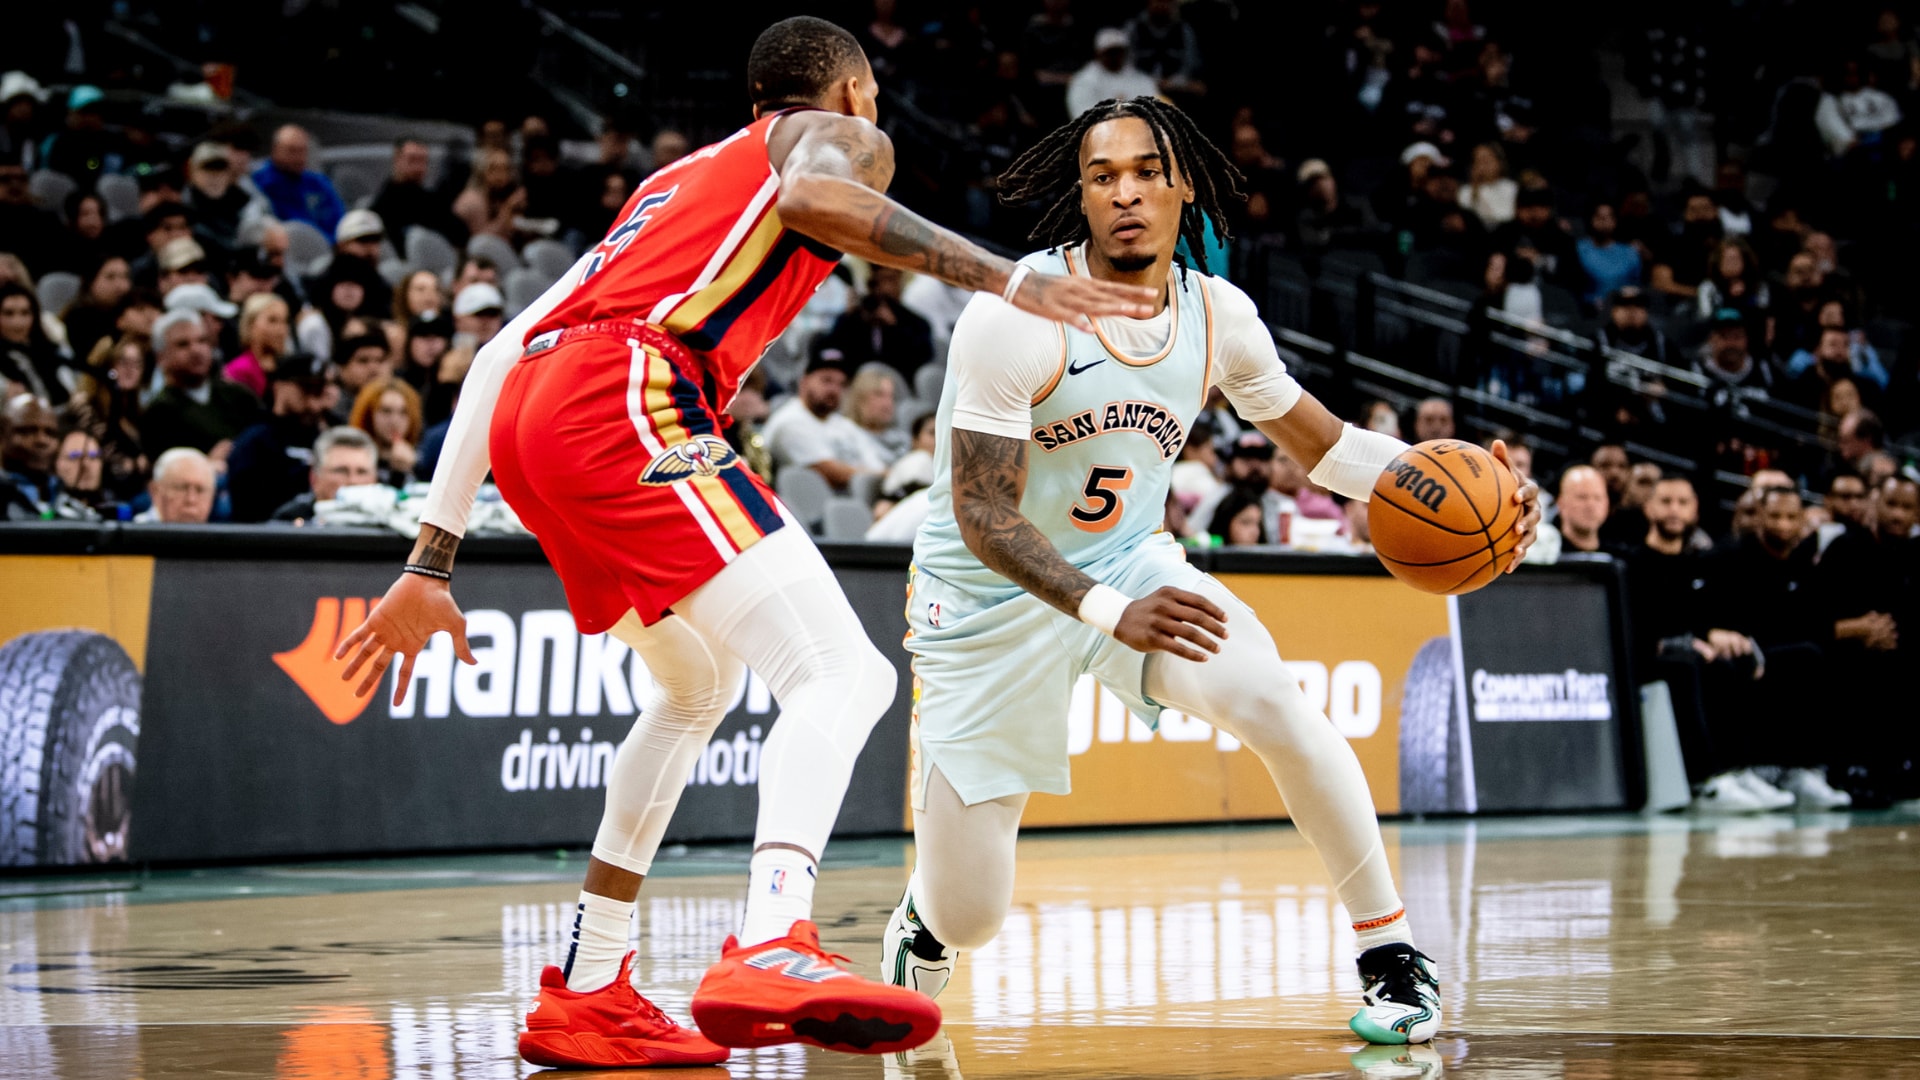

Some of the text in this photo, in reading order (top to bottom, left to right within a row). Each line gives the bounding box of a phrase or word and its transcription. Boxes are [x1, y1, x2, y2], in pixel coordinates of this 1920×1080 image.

[1032, 400, 1187, 461] SAN ANTONIO
[1068, 464, 1134, 533] 5
[502, 727, 622, 792] drivin
